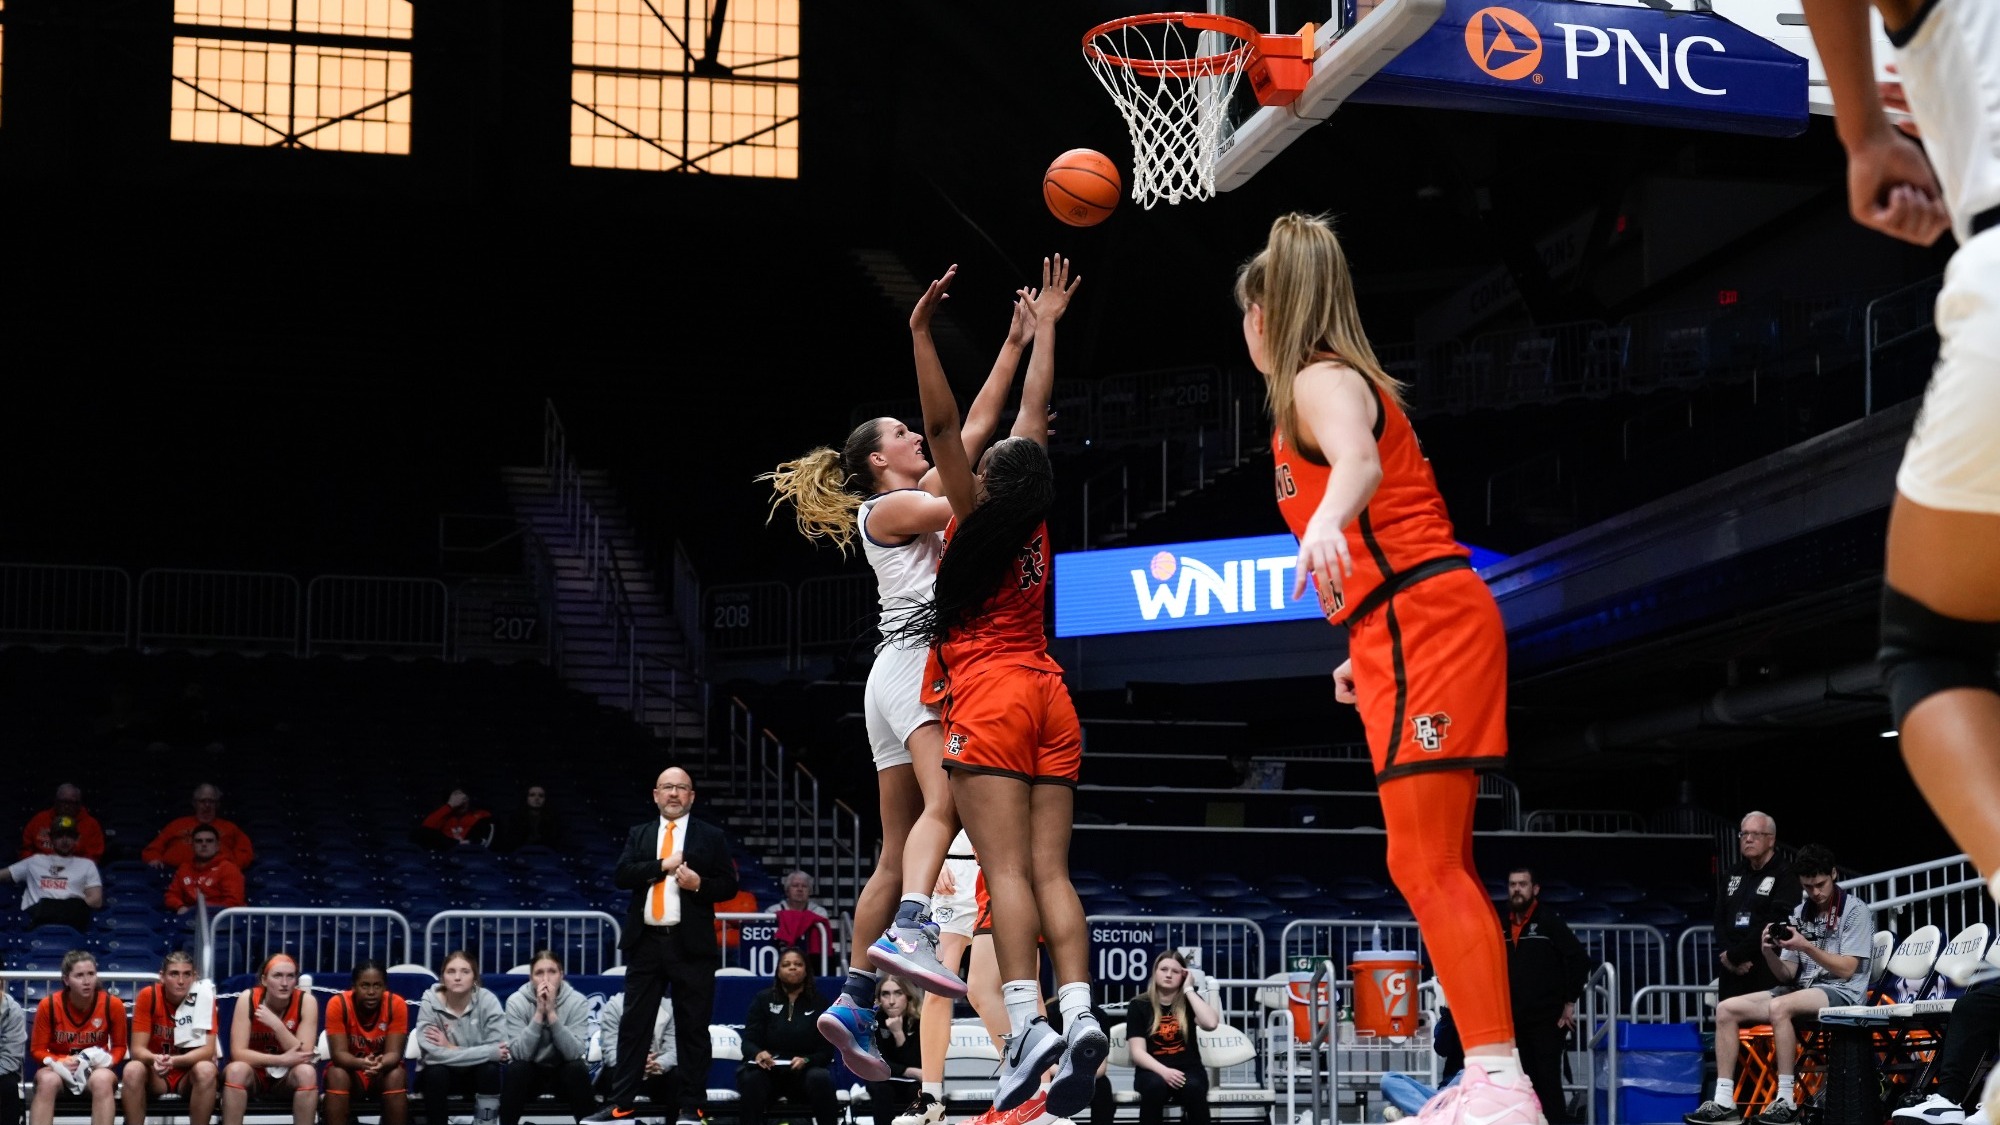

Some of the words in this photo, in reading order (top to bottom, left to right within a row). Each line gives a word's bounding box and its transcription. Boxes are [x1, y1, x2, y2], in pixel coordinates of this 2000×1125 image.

[1554, 22, 1727, 96] PNC
[1177, 383, 1209, 405] 208
[1130, 556, 1298, 620] WNIT
[714, 605, 749, 628] 208
[494, 617, 536, 640] 207
[742, 926, 780, 941] SECT
[1092, 929, 1153, 943] SECTION
[1896, 940, 1935, 957] BUTLER
[1943, 936, 1983, 956] BUTLER
[749, 945, 780, 977] 10
[1099, 947, 1148, 982] 108
[1387, 973, 1407, 996] G
[1200, 1036, 1244, 1049] UTLER
[1218, 1093, 1266, 1102] BULLDOGS
